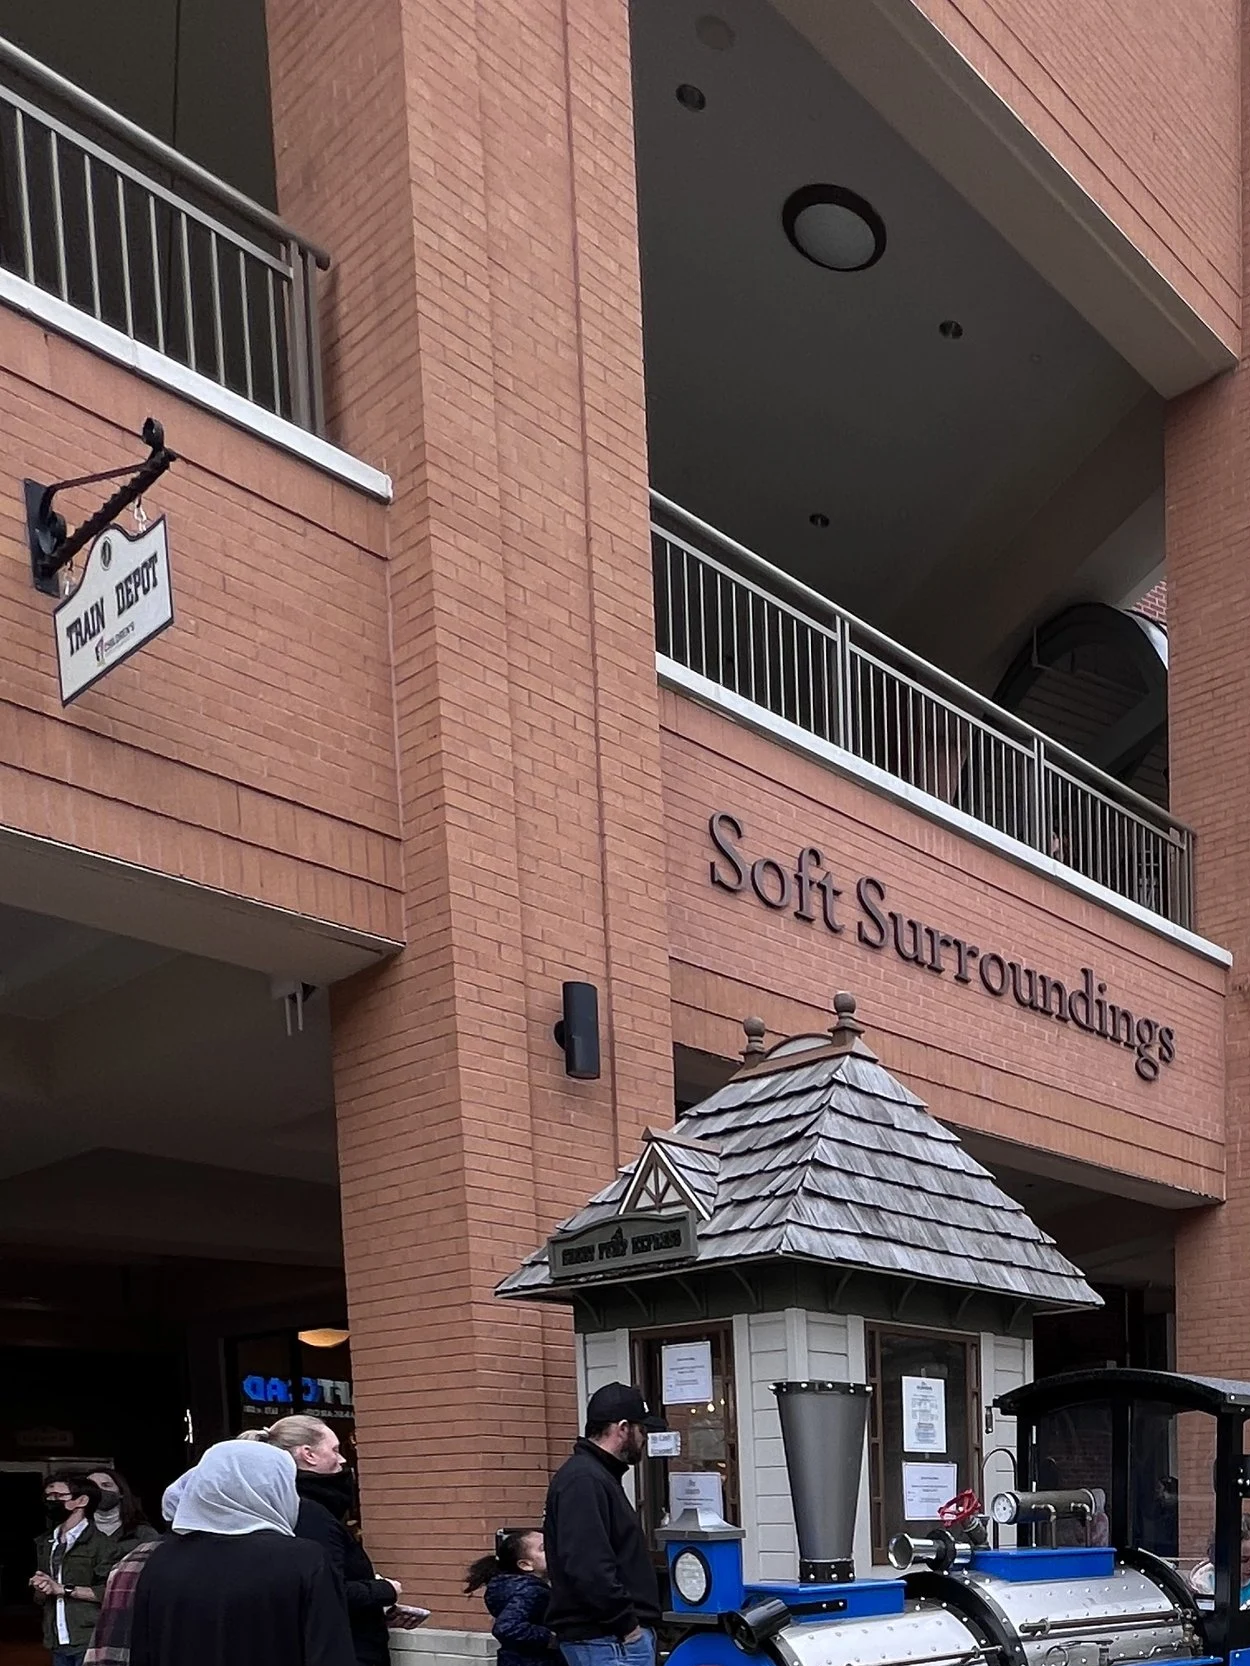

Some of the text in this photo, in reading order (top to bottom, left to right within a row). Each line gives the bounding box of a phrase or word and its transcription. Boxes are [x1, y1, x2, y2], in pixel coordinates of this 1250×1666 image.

[66, 551, 158, 657] TRAIN DEPOT
[708, 811, 1176, 1082] Soft Surroundings
